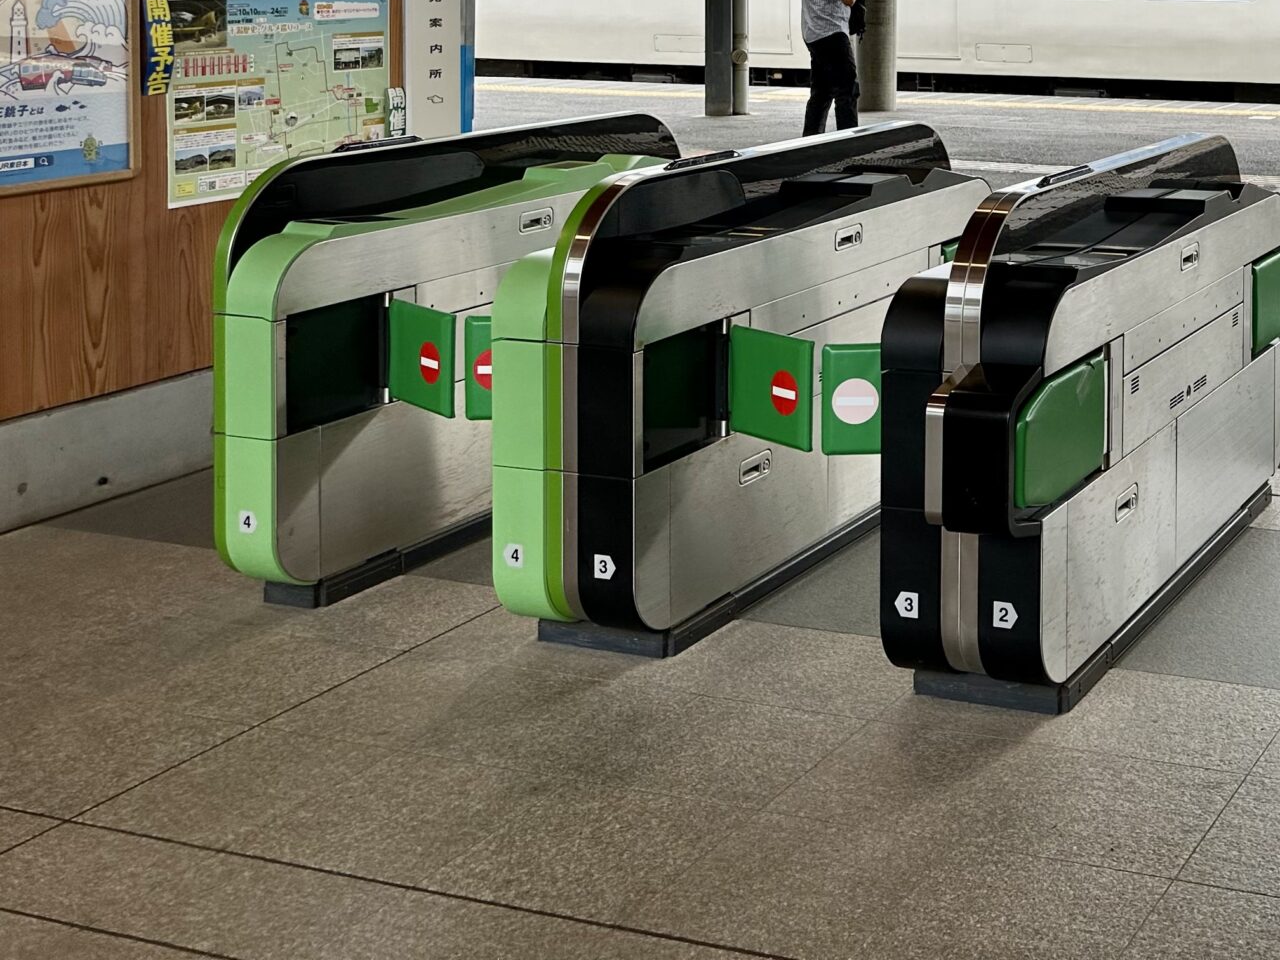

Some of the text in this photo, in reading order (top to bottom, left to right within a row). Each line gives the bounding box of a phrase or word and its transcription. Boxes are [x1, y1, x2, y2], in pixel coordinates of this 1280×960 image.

[243, 515, 252, 529] 4
[511, 548, 520, 562] 4
[599, 559, 608, 574] 3
[904, 597, 914, 612] 3
[998, 607, 1009, 622] 2
